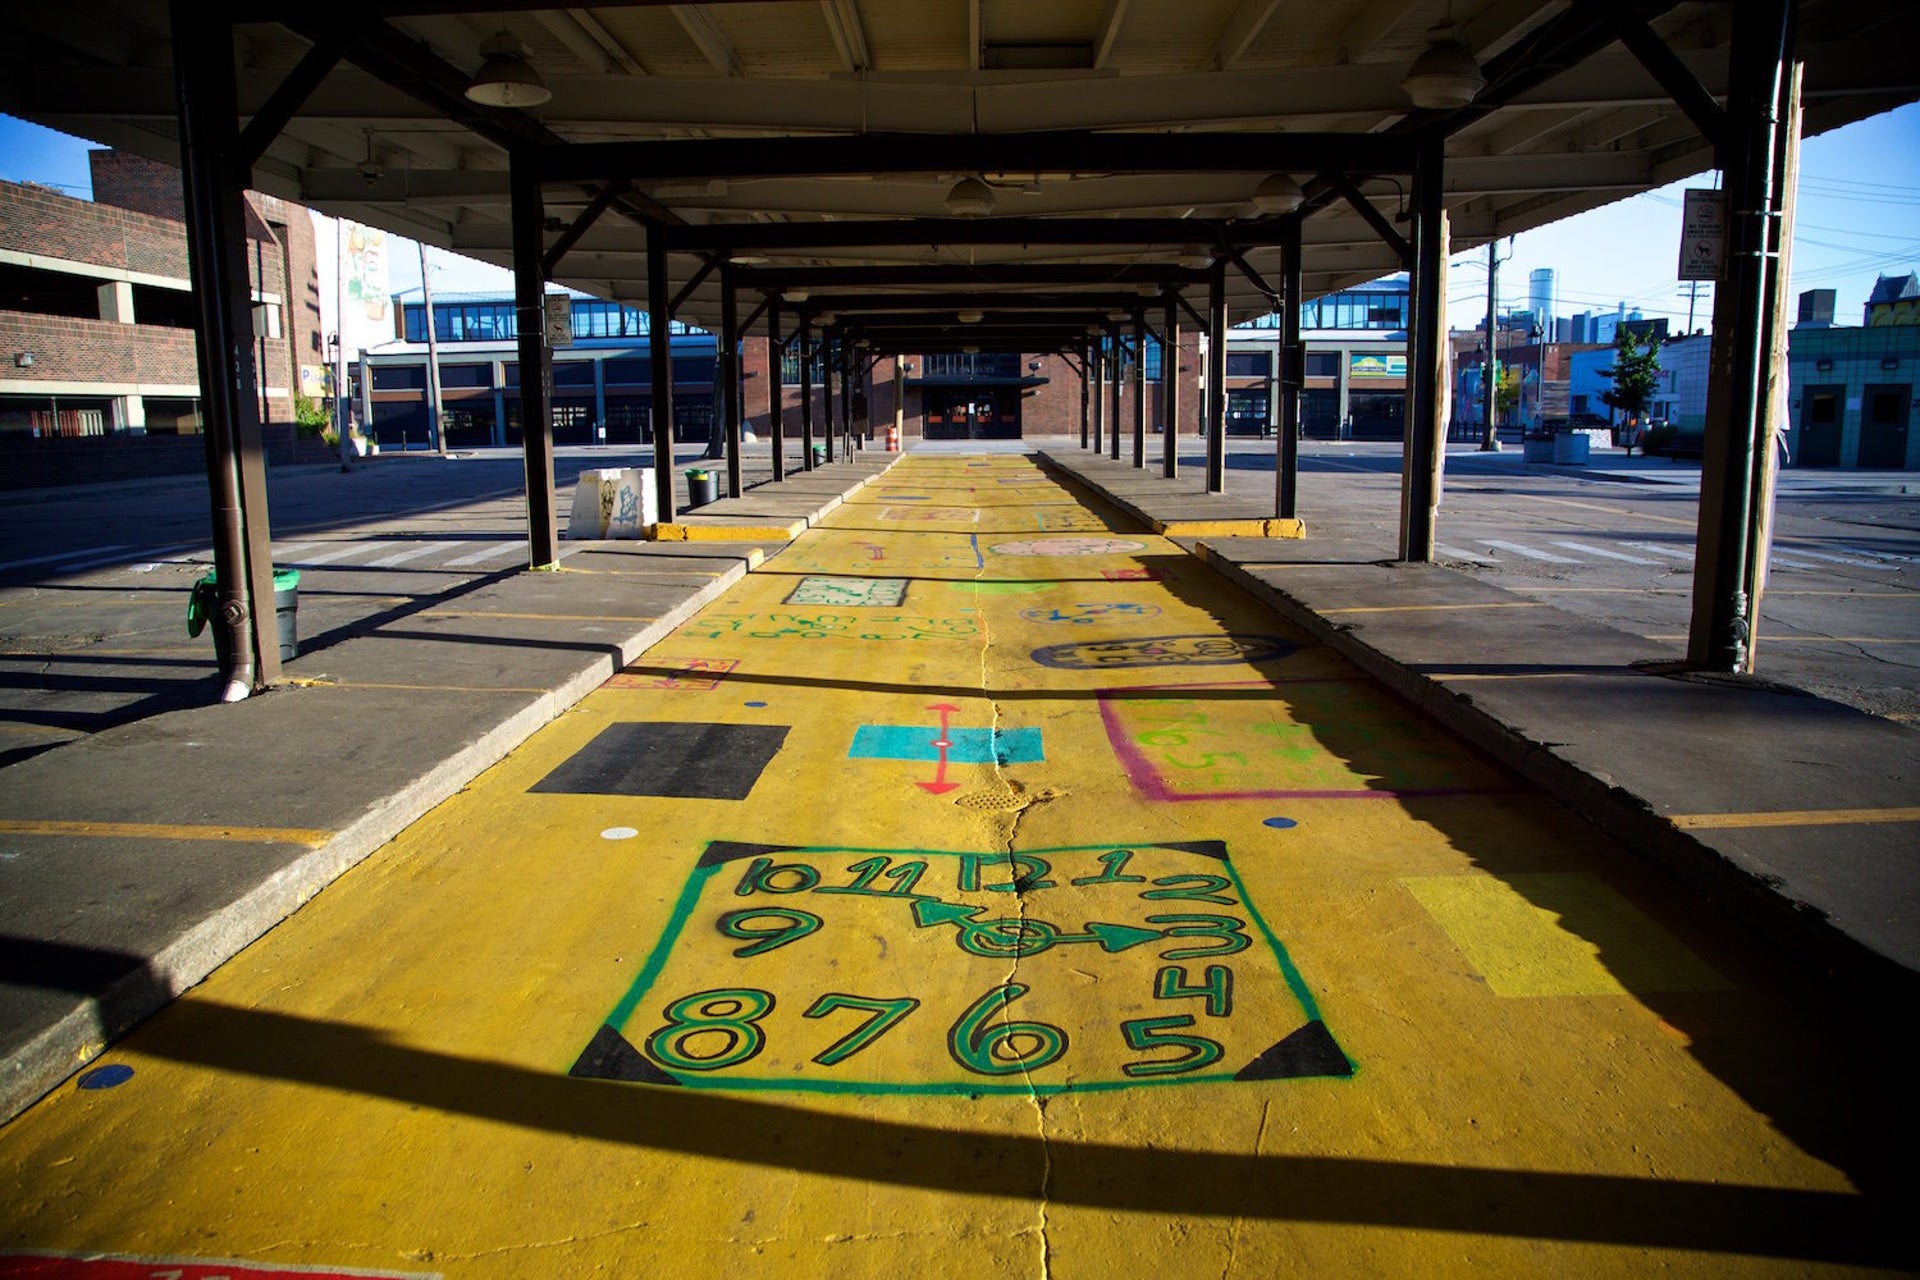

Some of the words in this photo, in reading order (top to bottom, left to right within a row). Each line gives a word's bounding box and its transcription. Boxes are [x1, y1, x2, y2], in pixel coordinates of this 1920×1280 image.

[734, 858, 821, 896] 10
[812, 856, 942, 901] 11
[957, 855, 1057, 892] 12
[1071, 850, 1146, 886] 1
[1138, 874, 1238, 905] 2
[716, 907, 824, 957] 9
[1145, 913, 1252, 960] 3
[1153, 966, 1233, 1017] 4
[644, 988, 776, 1071] 8
[802, 993, 920, 1066] 7
[947, 983, 1069, 1076] 6
[1120, 1015, 1224, 1077] 5
